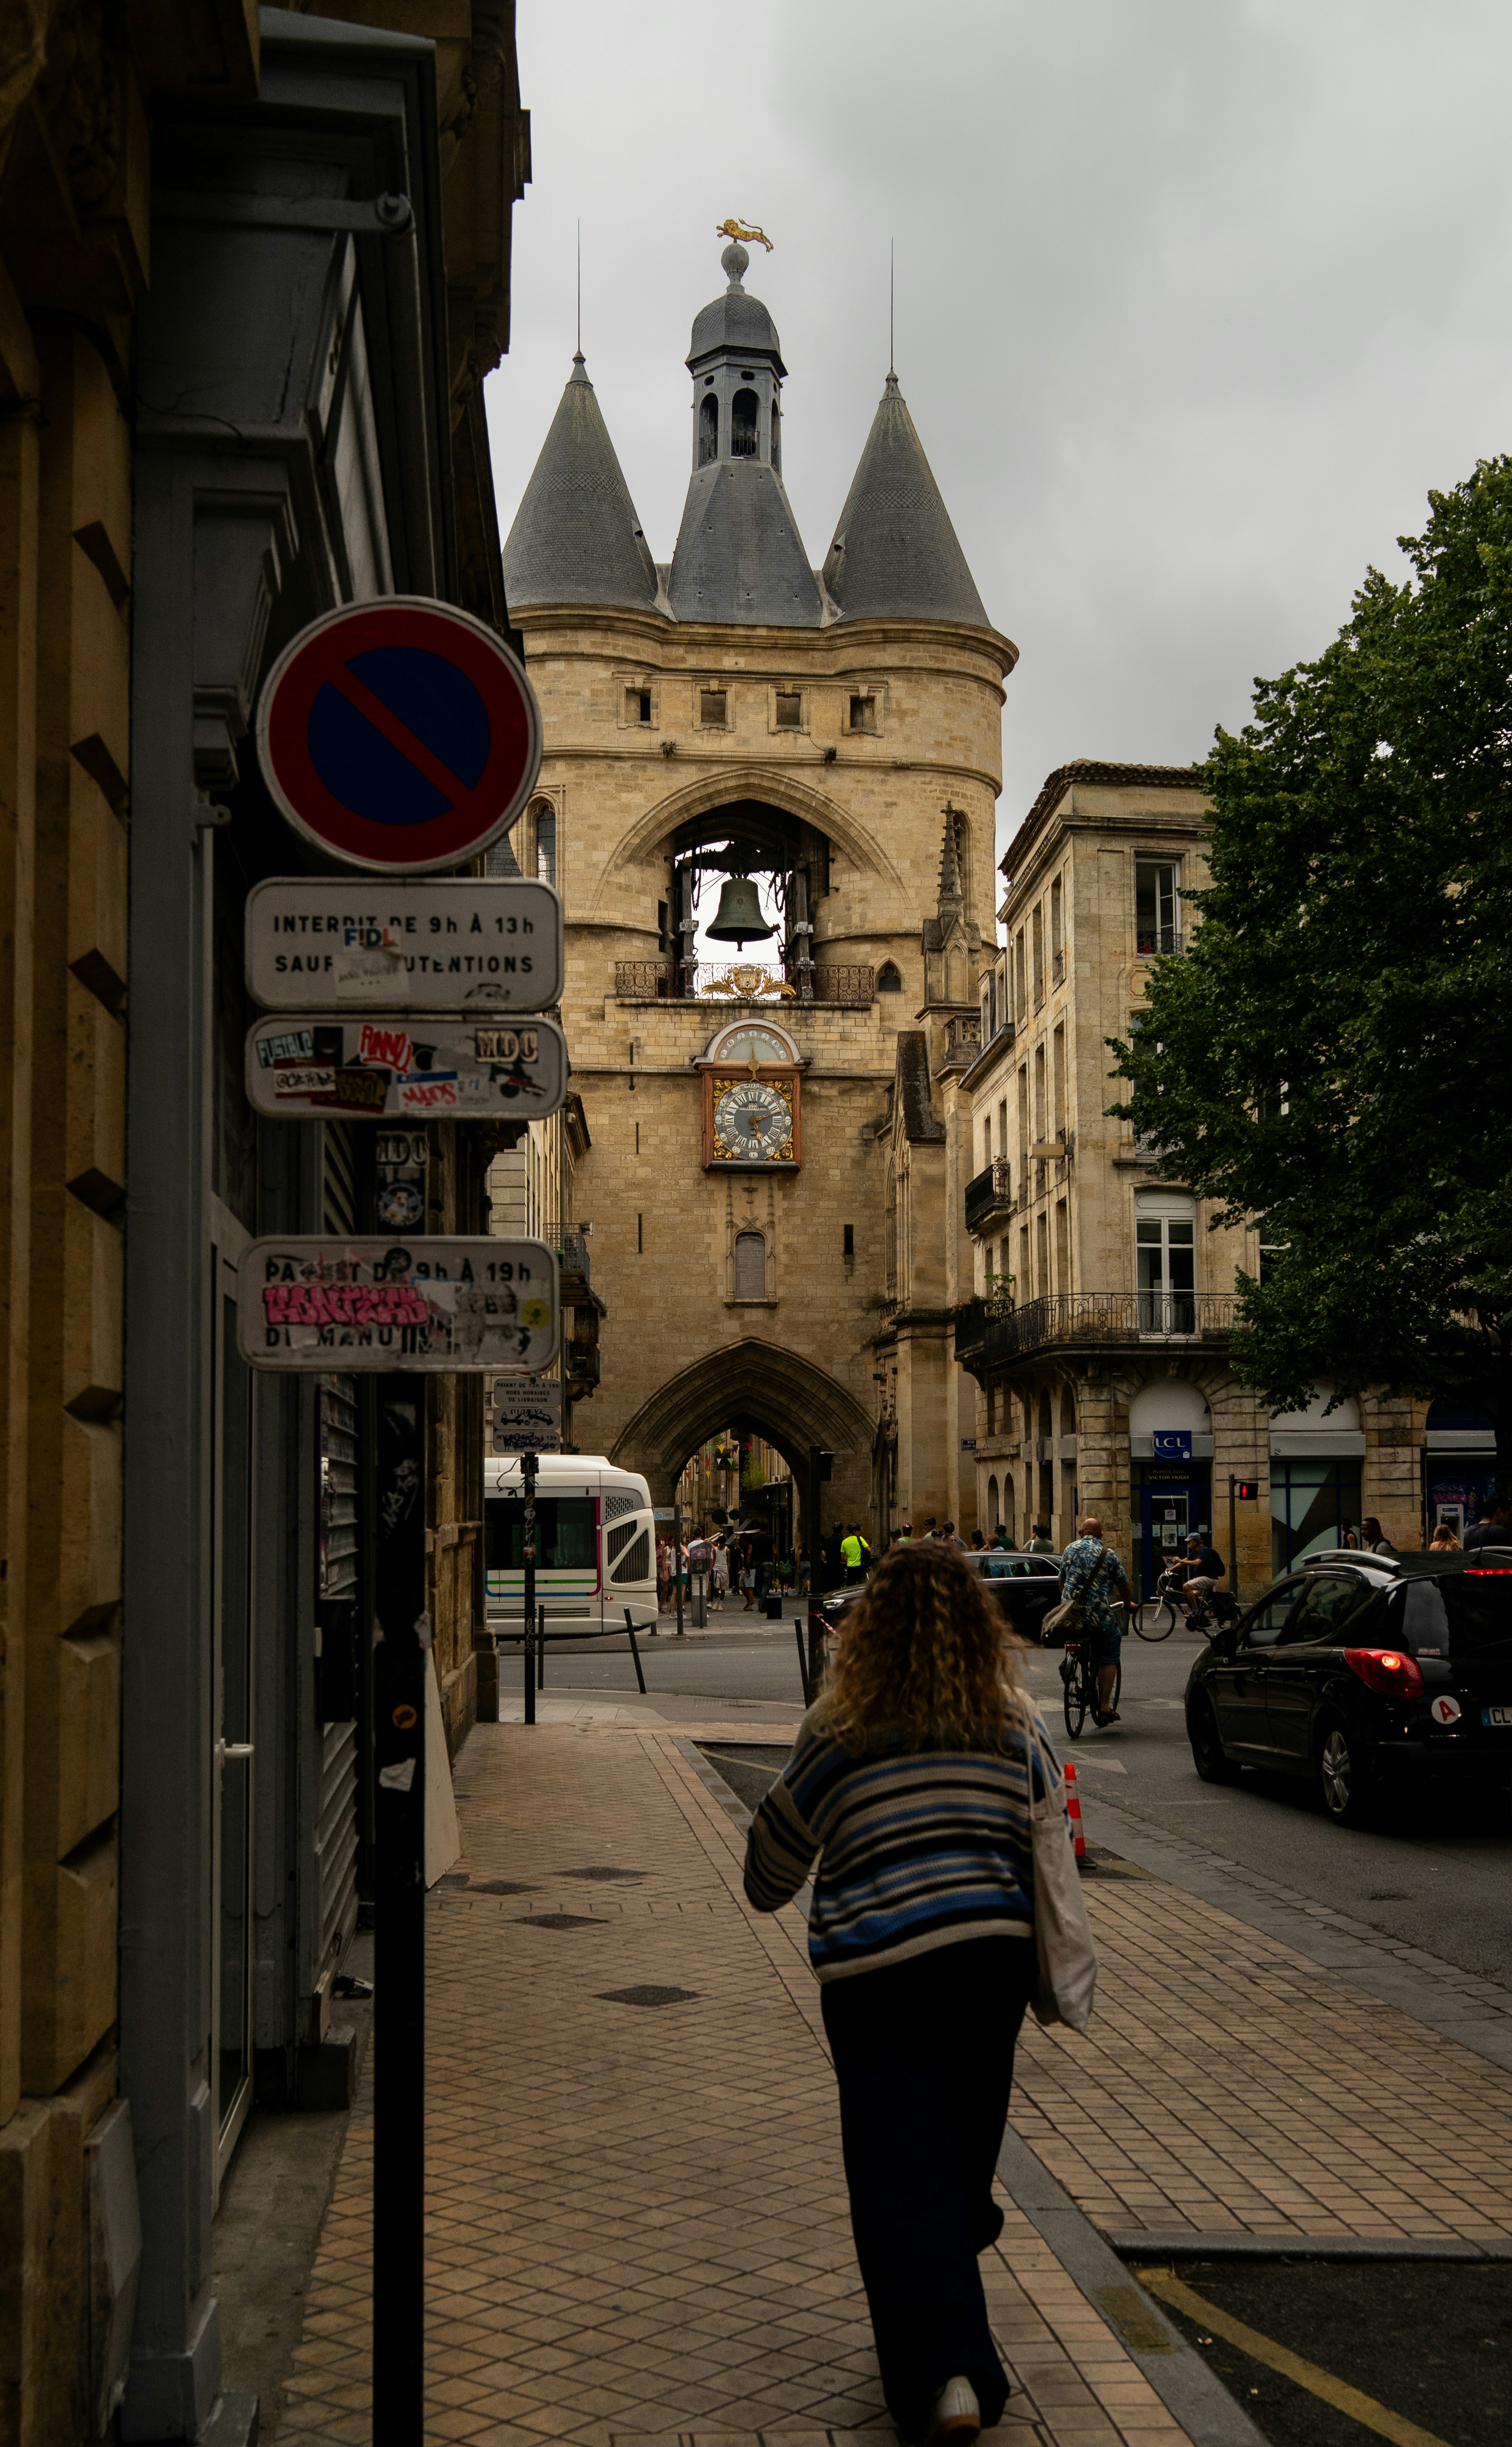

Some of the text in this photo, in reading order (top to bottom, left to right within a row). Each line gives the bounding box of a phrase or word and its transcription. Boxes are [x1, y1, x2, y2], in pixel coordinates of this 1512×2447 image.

[429, 916, 457, 933] 9h
[473, 913, 482, 933] À
[496, 917, 533, 933] 13h
[418, 1263, 446, 1282] 9h
[487, 1263, 530, 1282] 19h
[1155, 1437, 1186, 1448] LCL
[1439, 1700, 1456, 1722] A
